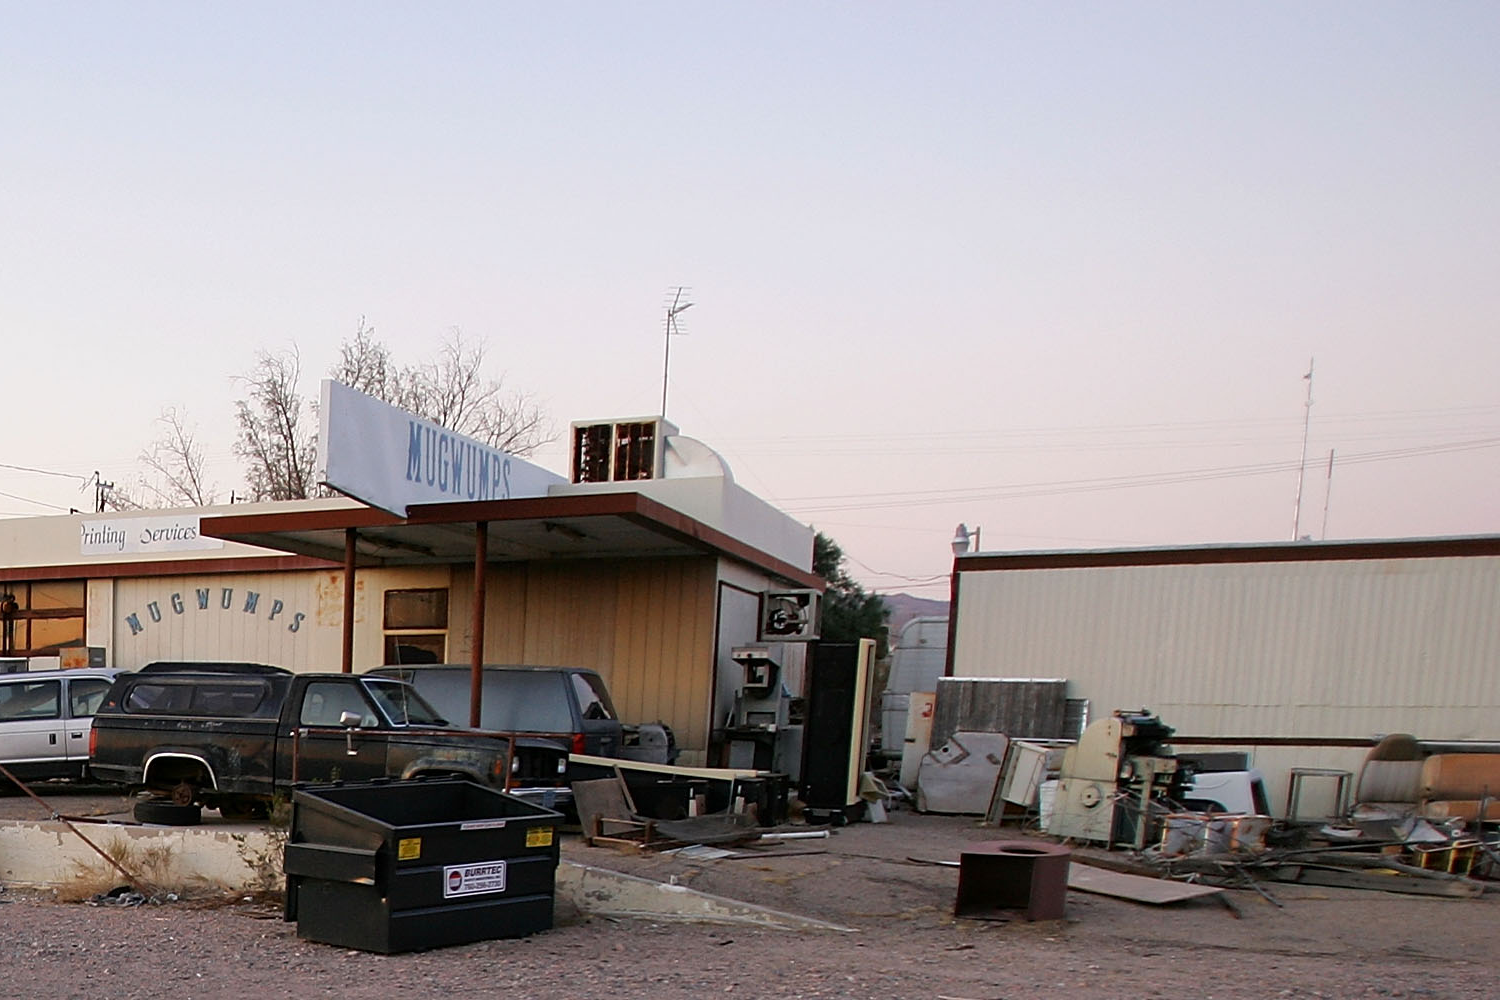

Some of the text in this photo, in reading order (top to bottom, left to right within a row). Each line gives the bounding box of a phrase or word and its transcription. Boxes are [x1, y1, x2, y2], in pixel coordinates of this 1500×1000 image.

[406, 421, 511, 500] MUGWUMPS
[140, 523, 197, 544] Services
[125, 587, 306, 636] MUGWUMPS
